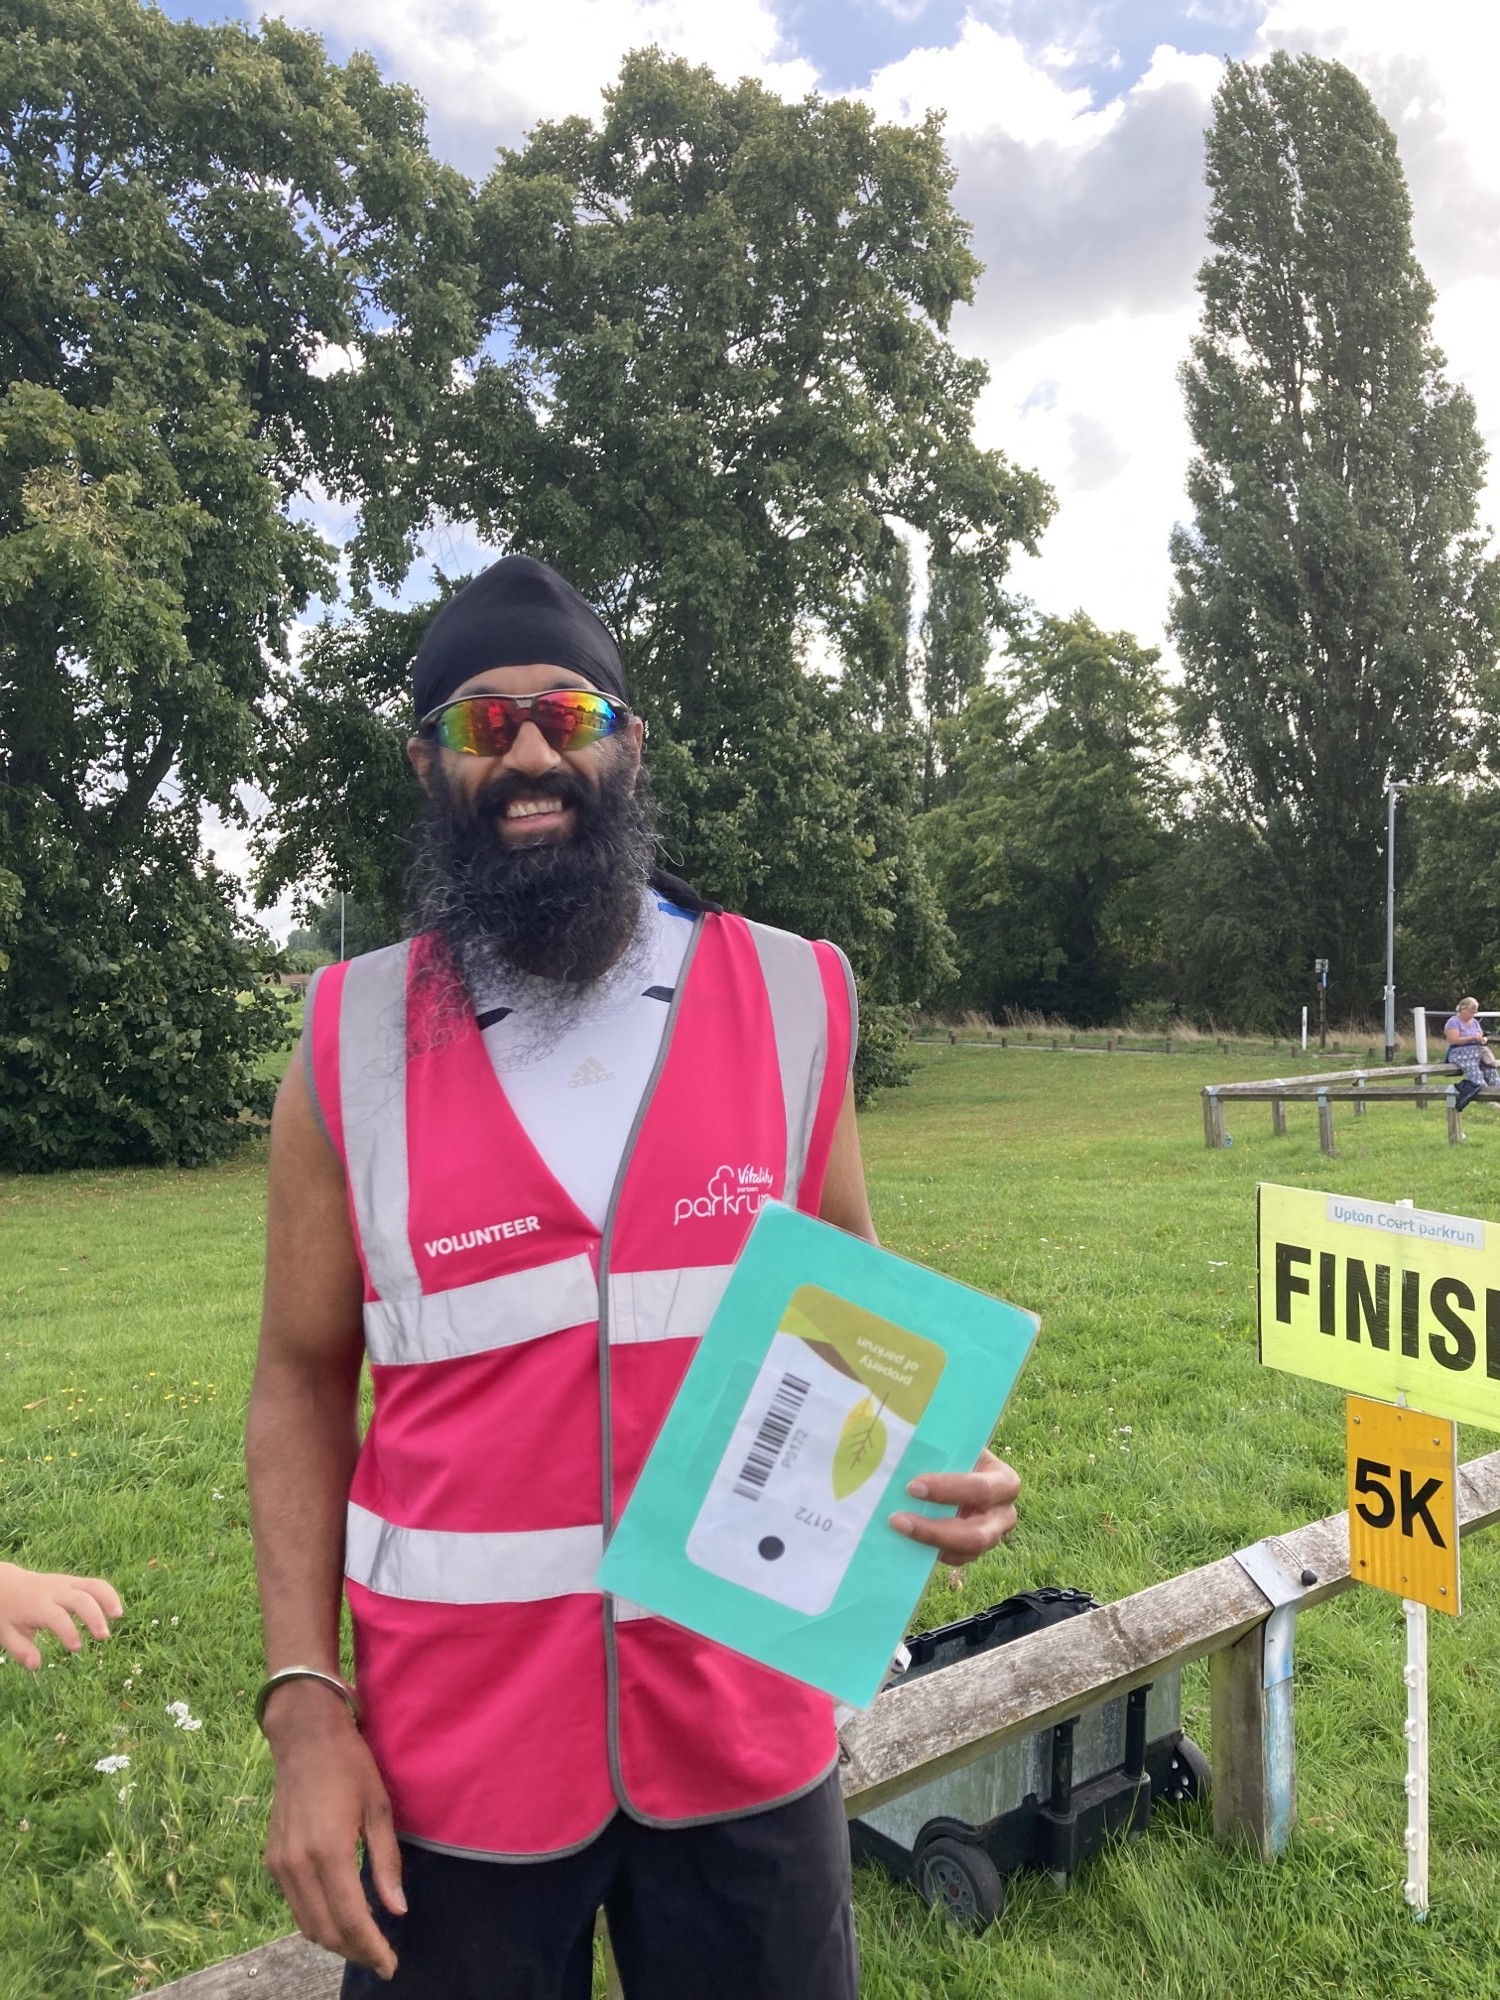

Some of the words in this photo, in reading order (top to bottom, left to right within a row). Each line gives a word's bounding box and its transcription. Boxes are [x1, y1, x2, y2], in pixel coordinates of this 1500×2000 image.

[737, 1164, 773, 1189] Vitality
[424, 1215, 541, 1258] VOLUNTEER
[1334, 1205, 1374, 1224] Upton
[1377, 1213, 1415, 1232] Court
[1419, 1222, 1475, 1244] parkrun
[857, 1336, 906, 1364] parkrun
[903, 1360, 919, 1372] of
[858, 1355, 914, 1387] property
[781, 1429, 808, 1469] P0172
[795, 1506, 832, 1532] 0172
[1354, 1457, 1447, 1550] 5K
